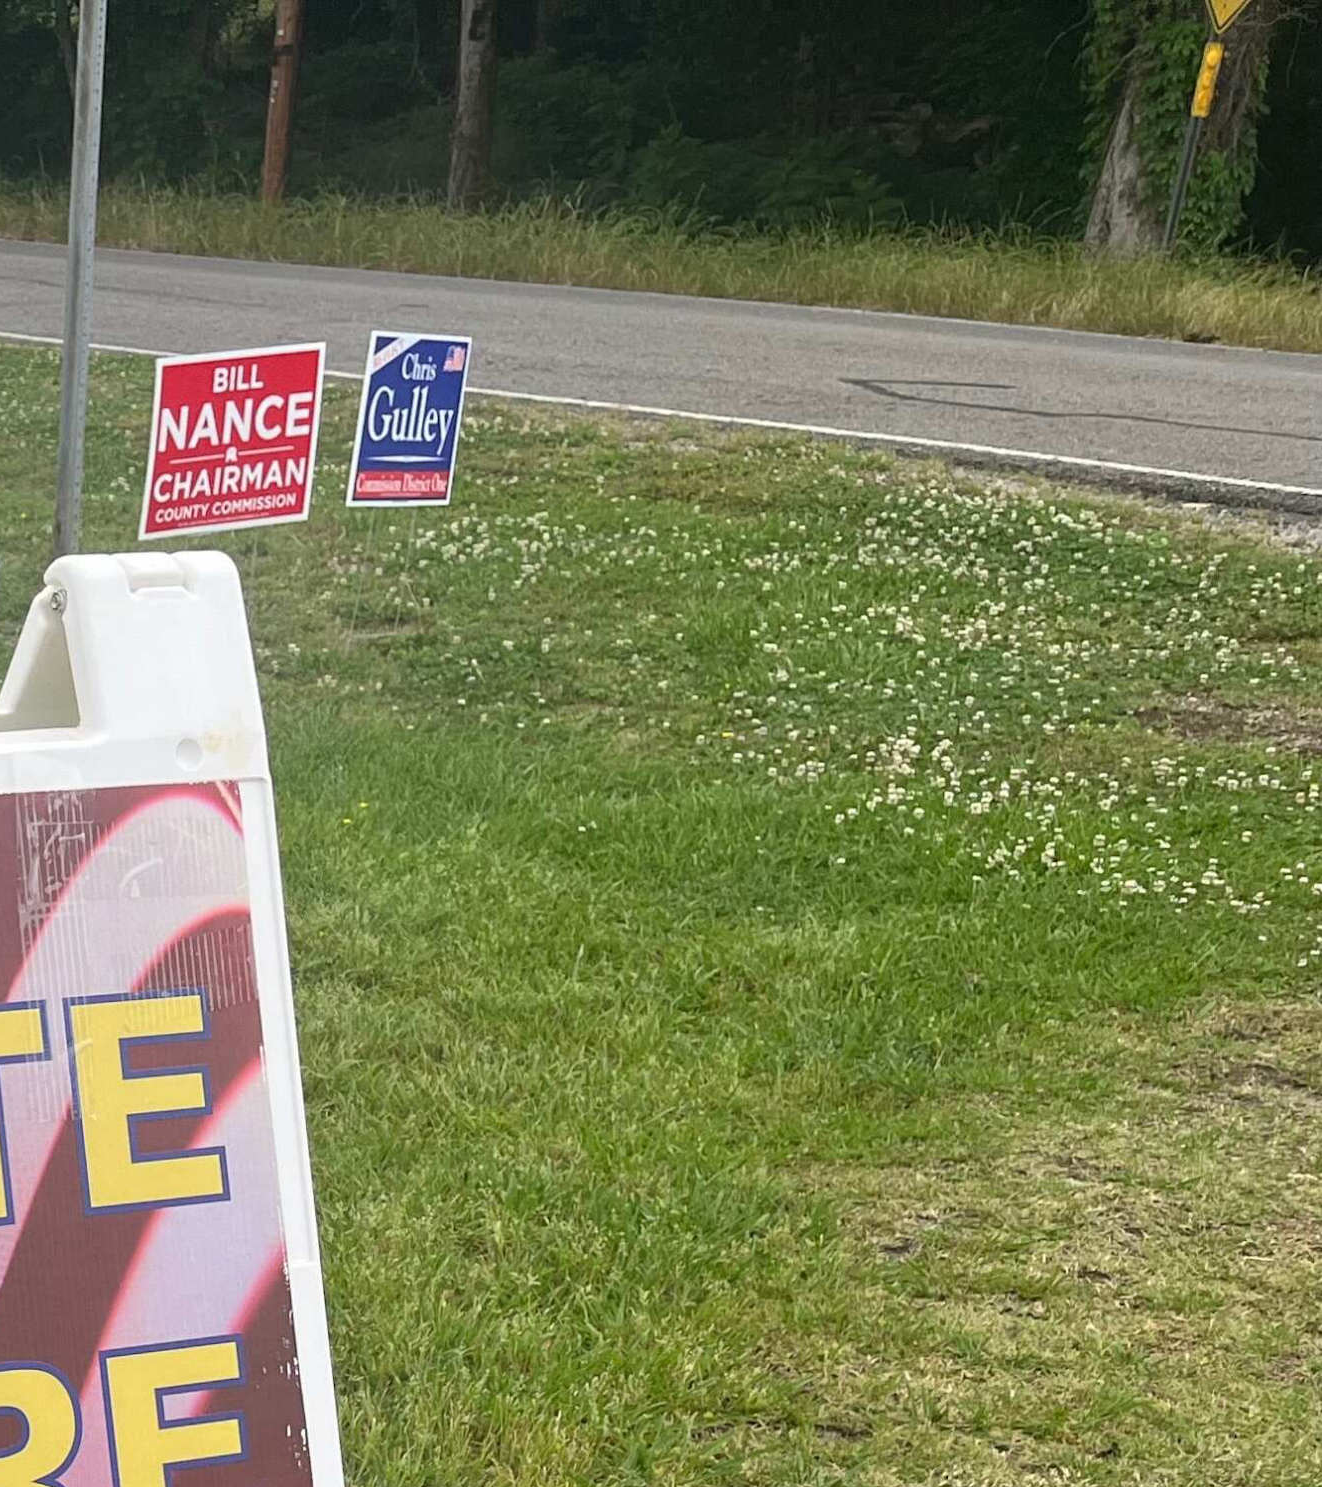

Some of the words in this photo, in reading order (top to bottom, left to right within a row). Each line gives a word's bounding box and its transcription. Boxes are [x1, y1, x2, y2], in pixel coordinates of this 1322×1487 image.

[213, 364, 264, 393] BILL
[402, 353, 437, 381] Chris
[158, 391, 313, 453] NANCE
[368, 385, 454, 456] Gulley
[153, 457, 306, 503] CHAIRMAN
[403, 473, 431, 491] District
[431, 472, 448, 491] One
[155, 503, 210, 523] COUNTY
[212, 493, 297, 515] COMMISSION
